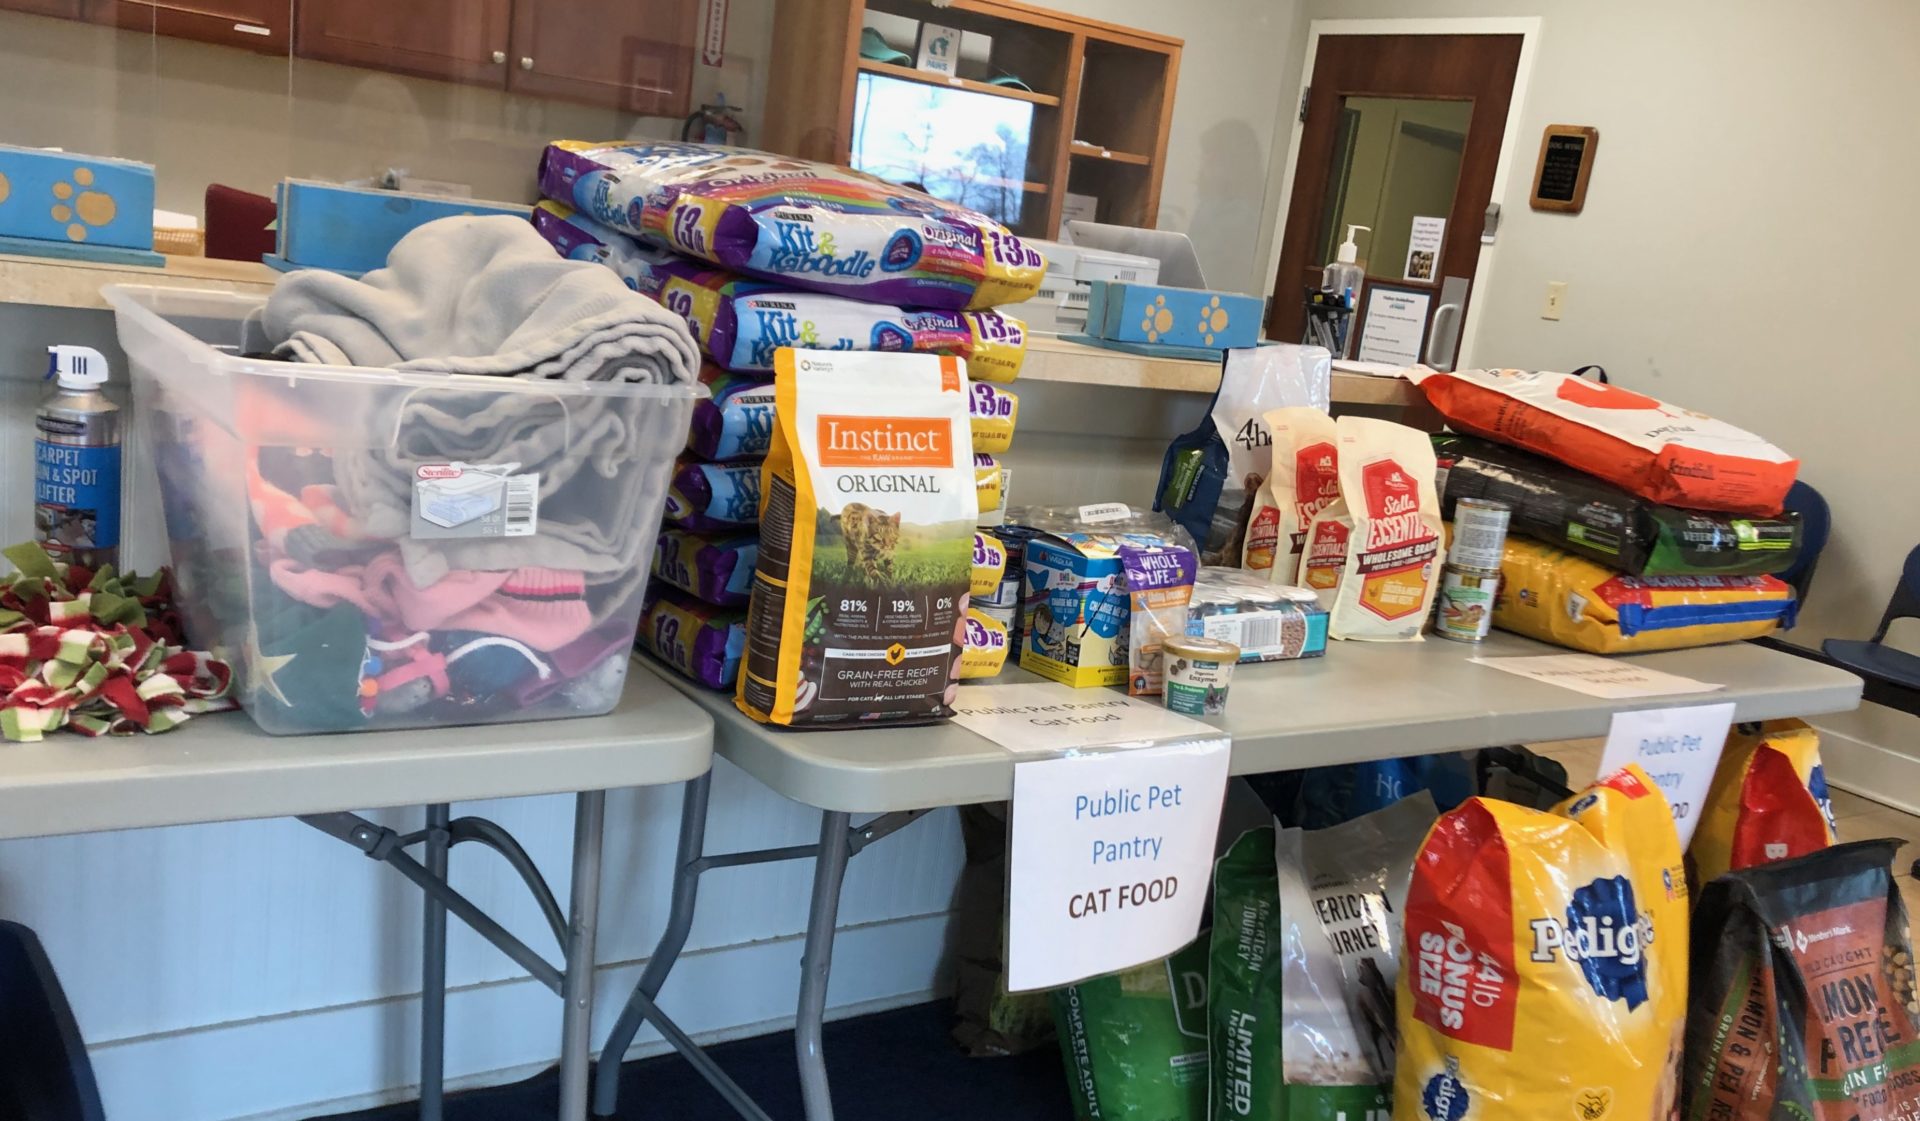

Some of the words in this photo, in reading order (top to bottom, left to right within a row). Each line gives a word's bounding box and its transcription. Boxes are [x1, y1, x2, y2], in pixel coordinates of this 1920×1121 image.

[673, 204, 702, 250] 13
[921, 223, 978, 248] Original
[774, 220, 819, 257] Kit
[819, 232, 836, 256] &
[988, 231, 1025, 267] 13
[1026, 249, 1042, 267] lb
[767, 248, 875, 278] Kaboodle
[755, 301, 797, 311] PURINA
[755, 309, 799, 347] Kit
[901, 315, 960, 333] Original
[970, 311, 1006, 342] 13
[741, 395, 775, 404] PURIN
[997, 396, 1011, 416] lb
[827, 420, 940, 452] Instinct
[37, 447, 80, 466] CARPET
[52, 471, 61, 482] &
[63, 470, 97, 485] SPOT
[837, 474, 941, 494] ORIGINAL
[38, 485, 76, 504] LIFTER
[988, 549, 1001, 567] lb
[1139, 555, 1182, 571] WHOLE
[1148, 569, 1171, 586] LIFE
[840, 599, 868, 613] 81%
[892, 600, 915, 613] 19%
[936, 598, 952, 610] 0%
[990, 632, 1004, 647] lb
[837, 669, 905, 680] GRAIN-FREE
[906, 666, 940, 677] RECIPE
[849, 681, 871, 689] WITH
[871, 680, 893, 688] REAL
[895, 678, 928, 687] CHICKEN
[1189, 675, 1218, 683] Enzymes
[959, 703, 1027, 718] Public
[1027, 703, 1062, 715] Pet
[1030, 716, 1069, 727] Cat
[1070, 712, 1123, 725] Food
[1639, 736, 1678, 756] Public
[1681, 734, 1703, 751] Pet
[1646, 771, 1686, 789] antry
[1075, 788, 1142, 820] Public
[1148, 784, 1182, 809] Pet
[1093, 836, 1163, 865] Pantry
[1069, 888, 1112, 919] CAT
[1118, 876, 1178, 910] FOOD
[1237, 905, 1257, 962] JOURNEY
[1418, 930, 1446, 998] SIZE
[1712, 1013, 1733, 1054] GRAIN
[1068, 985, 1090, 1065] COMPLETE
[1082, 1069, 1101, 1119] ADULT
[1225, 1008, 1241, 1112] INGREDIENT
[1234, 1012, 1257, 1117] LIMITED
[1702, 1055, 1718, 1087] FREE
